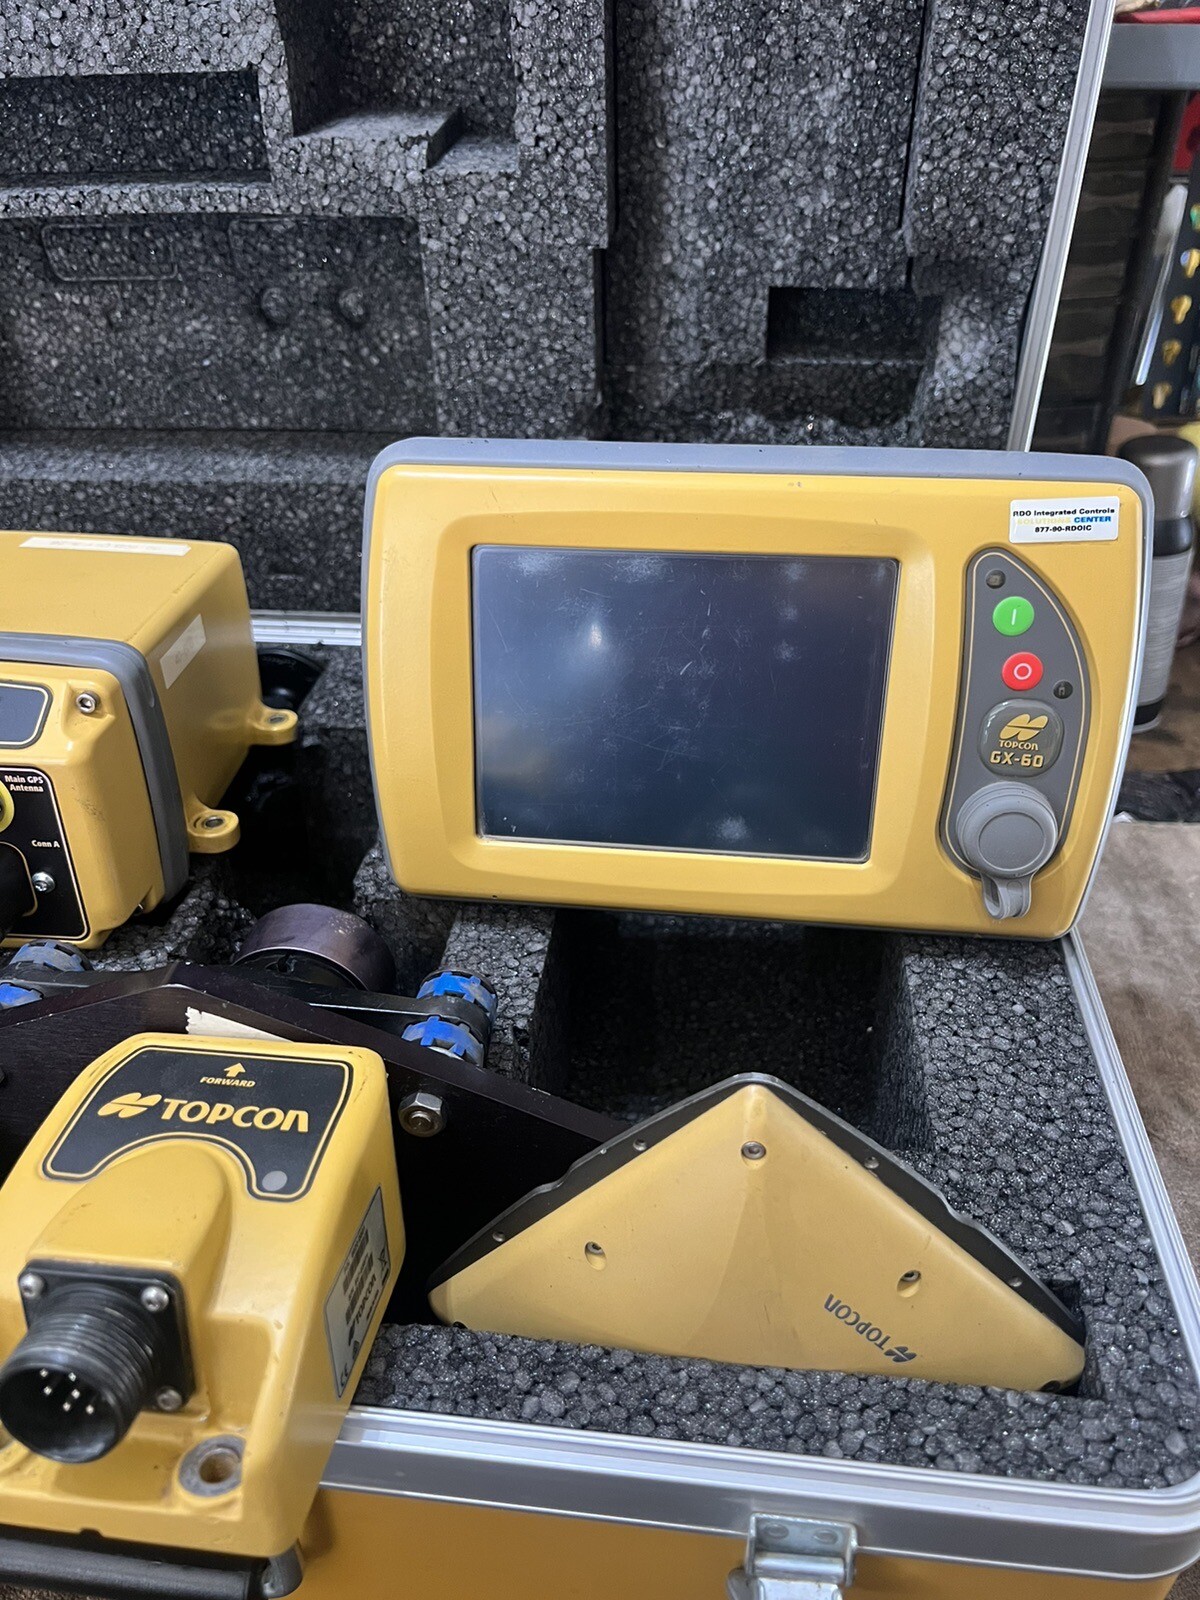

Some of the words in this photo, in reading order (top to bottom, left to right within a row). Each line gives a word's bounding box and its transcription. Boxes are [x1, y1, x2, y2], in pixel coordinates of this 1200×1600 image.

[1034, 509, 1077, 517] Integrated
[1017, 516, 1071, 525] SOLUTIONS
[999, 740, 1039, 751] TOPCON
[990, 750, 1044, 768] GX-60
[4, 775, 26, 783] Main
[27, 775, 44, 784] GPS
[9, 784, 44, 792] Antenna
[31, 839, 52, 848] Conn
[53, 840, 60, 848] A
[199, 1076, 256, 1088] FORWARD
[161, 1098, 309, 1133] TOPCON
[353, 1273, 377, 1325] TOPCON
[824, 1293, 891, 1351] TOPCON
